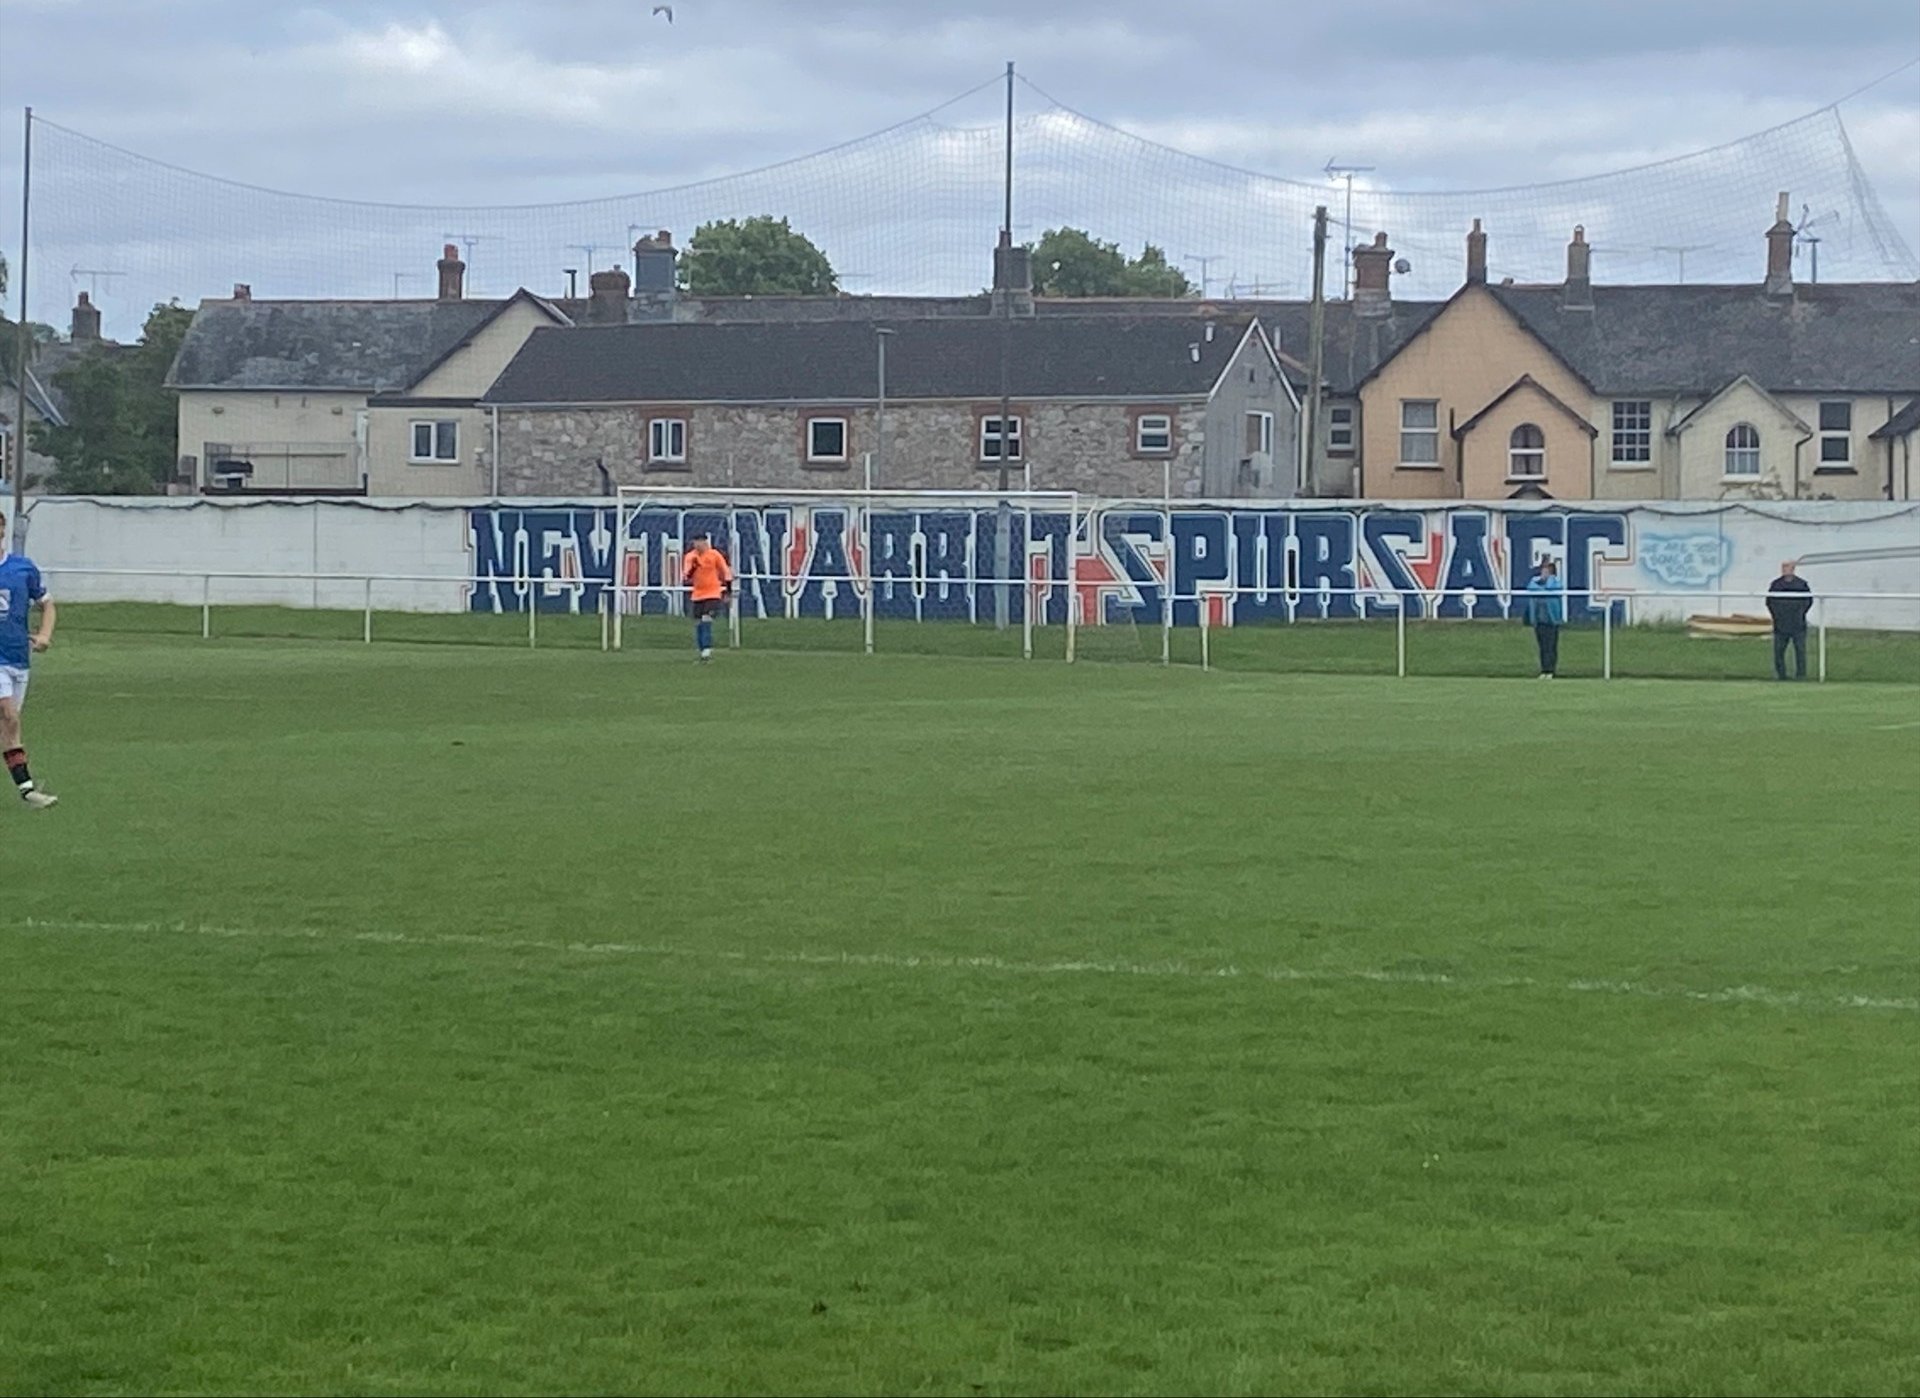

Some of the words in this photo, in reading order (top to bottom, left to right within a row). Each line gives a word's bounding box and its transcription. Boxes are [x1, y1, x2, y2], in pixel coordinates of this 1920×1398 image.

[794, 509, 1091, 624] ABBOT
[1099, 510, 1429, 625] SPURS
[1434, 510, 1632, 622] AFC
